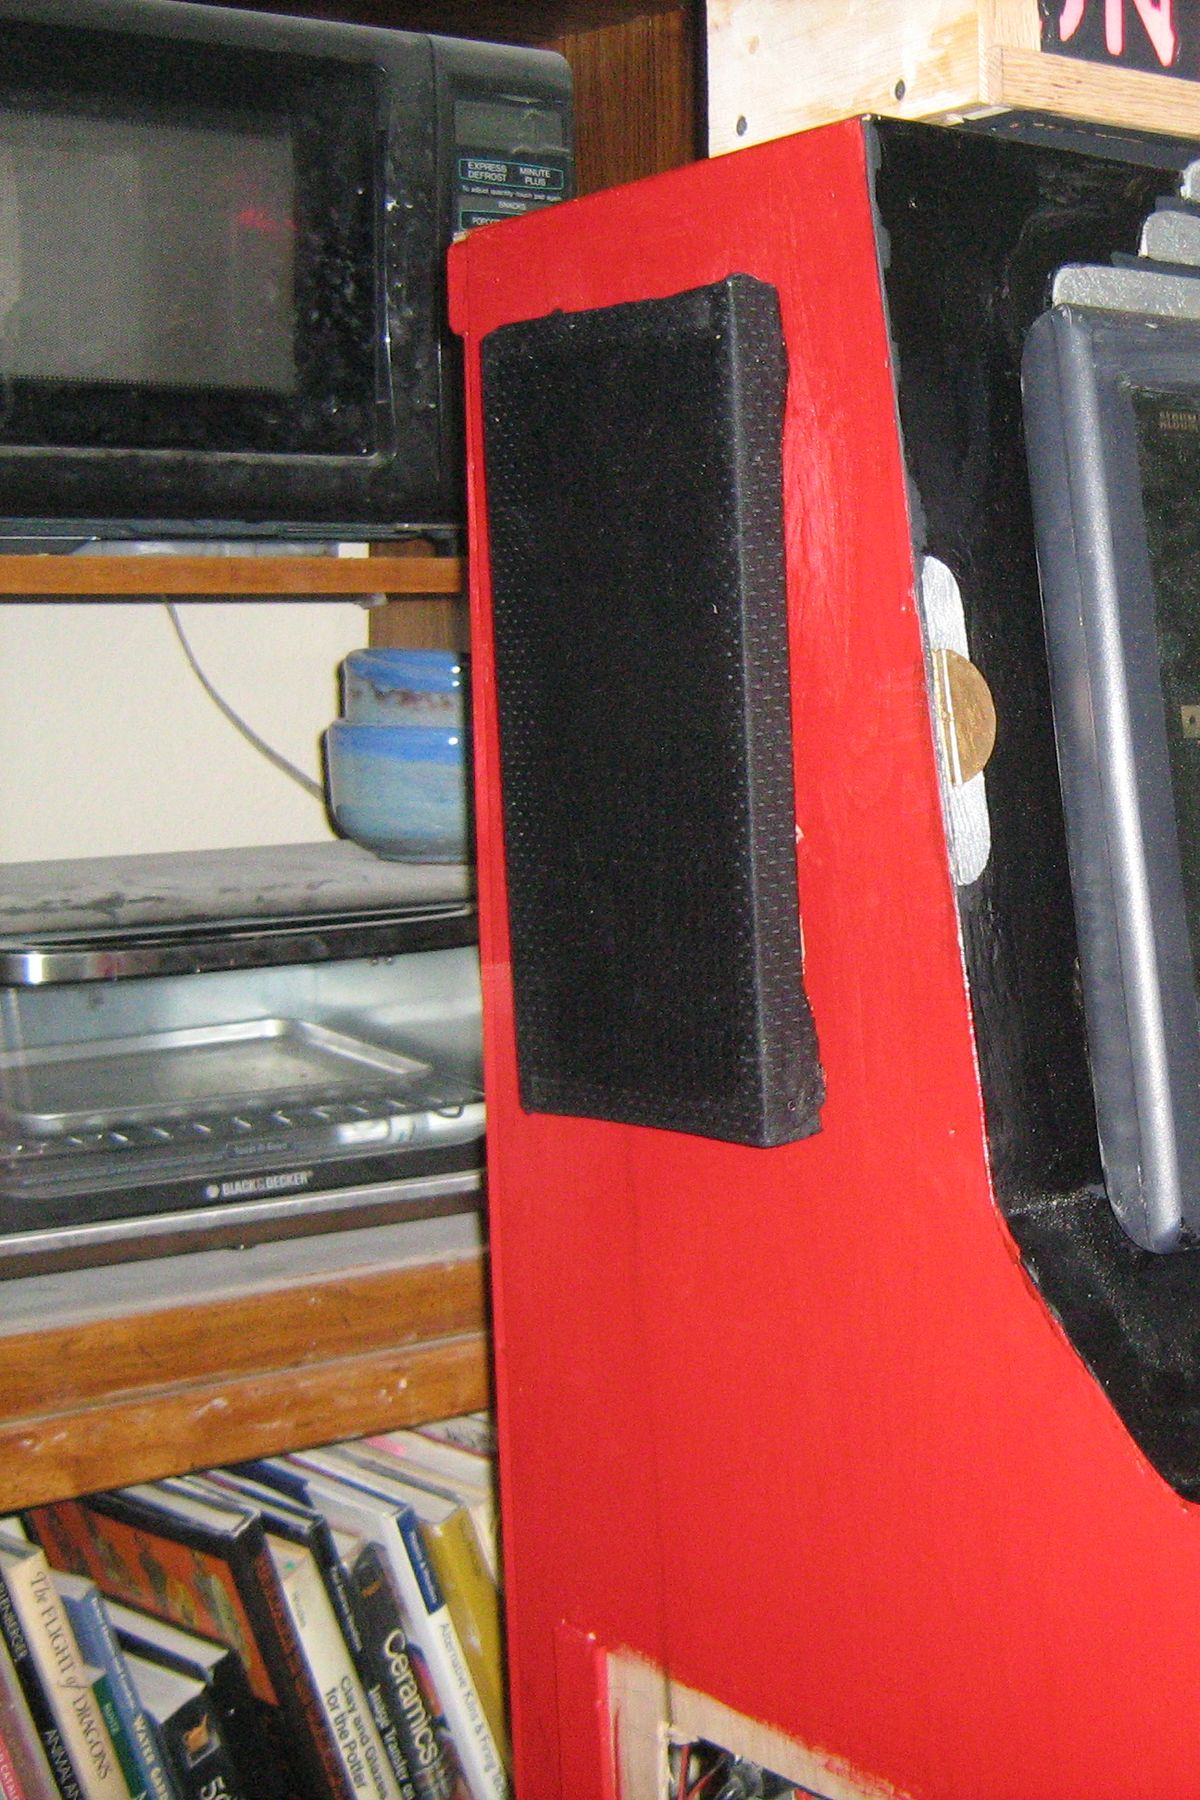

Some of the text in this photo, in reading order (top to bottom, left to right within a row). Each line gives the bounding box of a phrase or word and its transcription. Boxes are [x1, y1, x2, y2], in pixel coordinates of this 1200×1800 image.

[467, 161, 507, 174] EXPRESS
[467, 170, 507, 182] DEFROST
[519, 167, 551, 178] MINUTE
[525, 175, 547, 187] PLUS
[30, 1570, 50, 1603] The
[41, 1605, 76, 1674] FLIGHT
[73, 1694, 113, 1780] DRAGONS
[440, 1622, 468, 1688] Alternative
[340, 1675, 358, 1714] Clay
[353, 1716, 371, 1747] and
[384, 1627, 439, 1766] Ceramics
[325, 1687, 367, 1790] for the Potter
[368, 1683, 390, 1730] Image
[384, 1728, 411, 1782] Transfer
